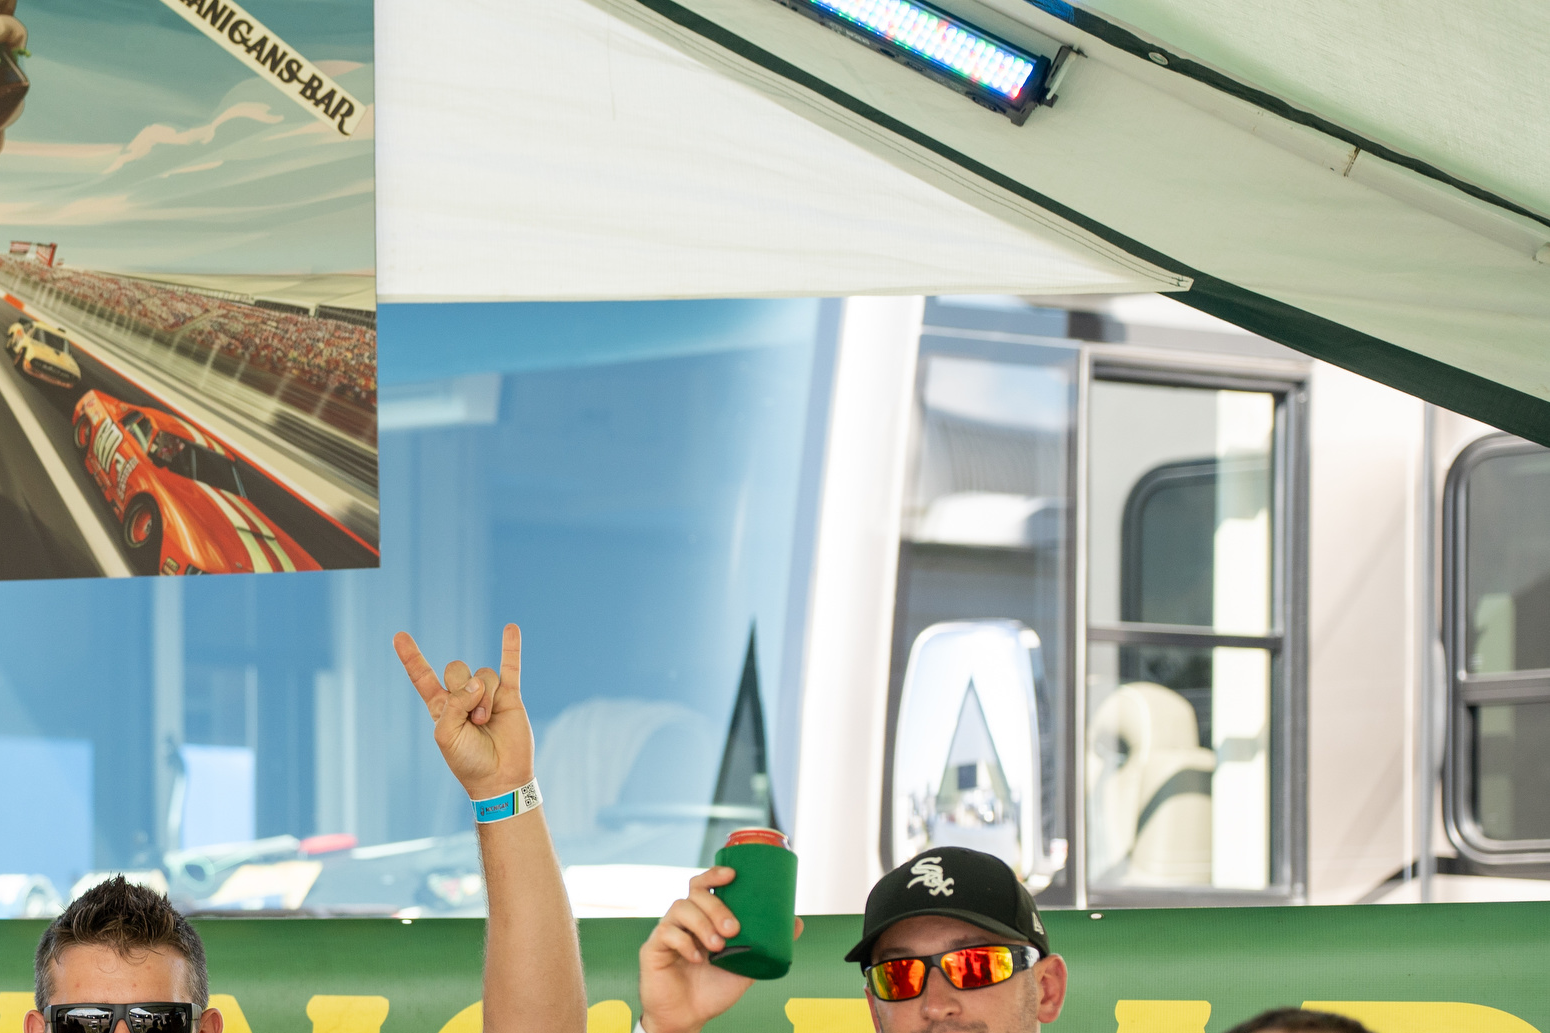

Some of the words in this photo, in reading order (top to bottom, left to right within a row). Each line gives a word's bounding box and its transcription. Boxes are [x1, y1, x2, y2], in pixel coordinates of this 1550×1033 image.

[180, 0, 302, 85] ANIGANS
[299, 73, 355, 137] BAR
[906, 856, 955, 897] Sox
